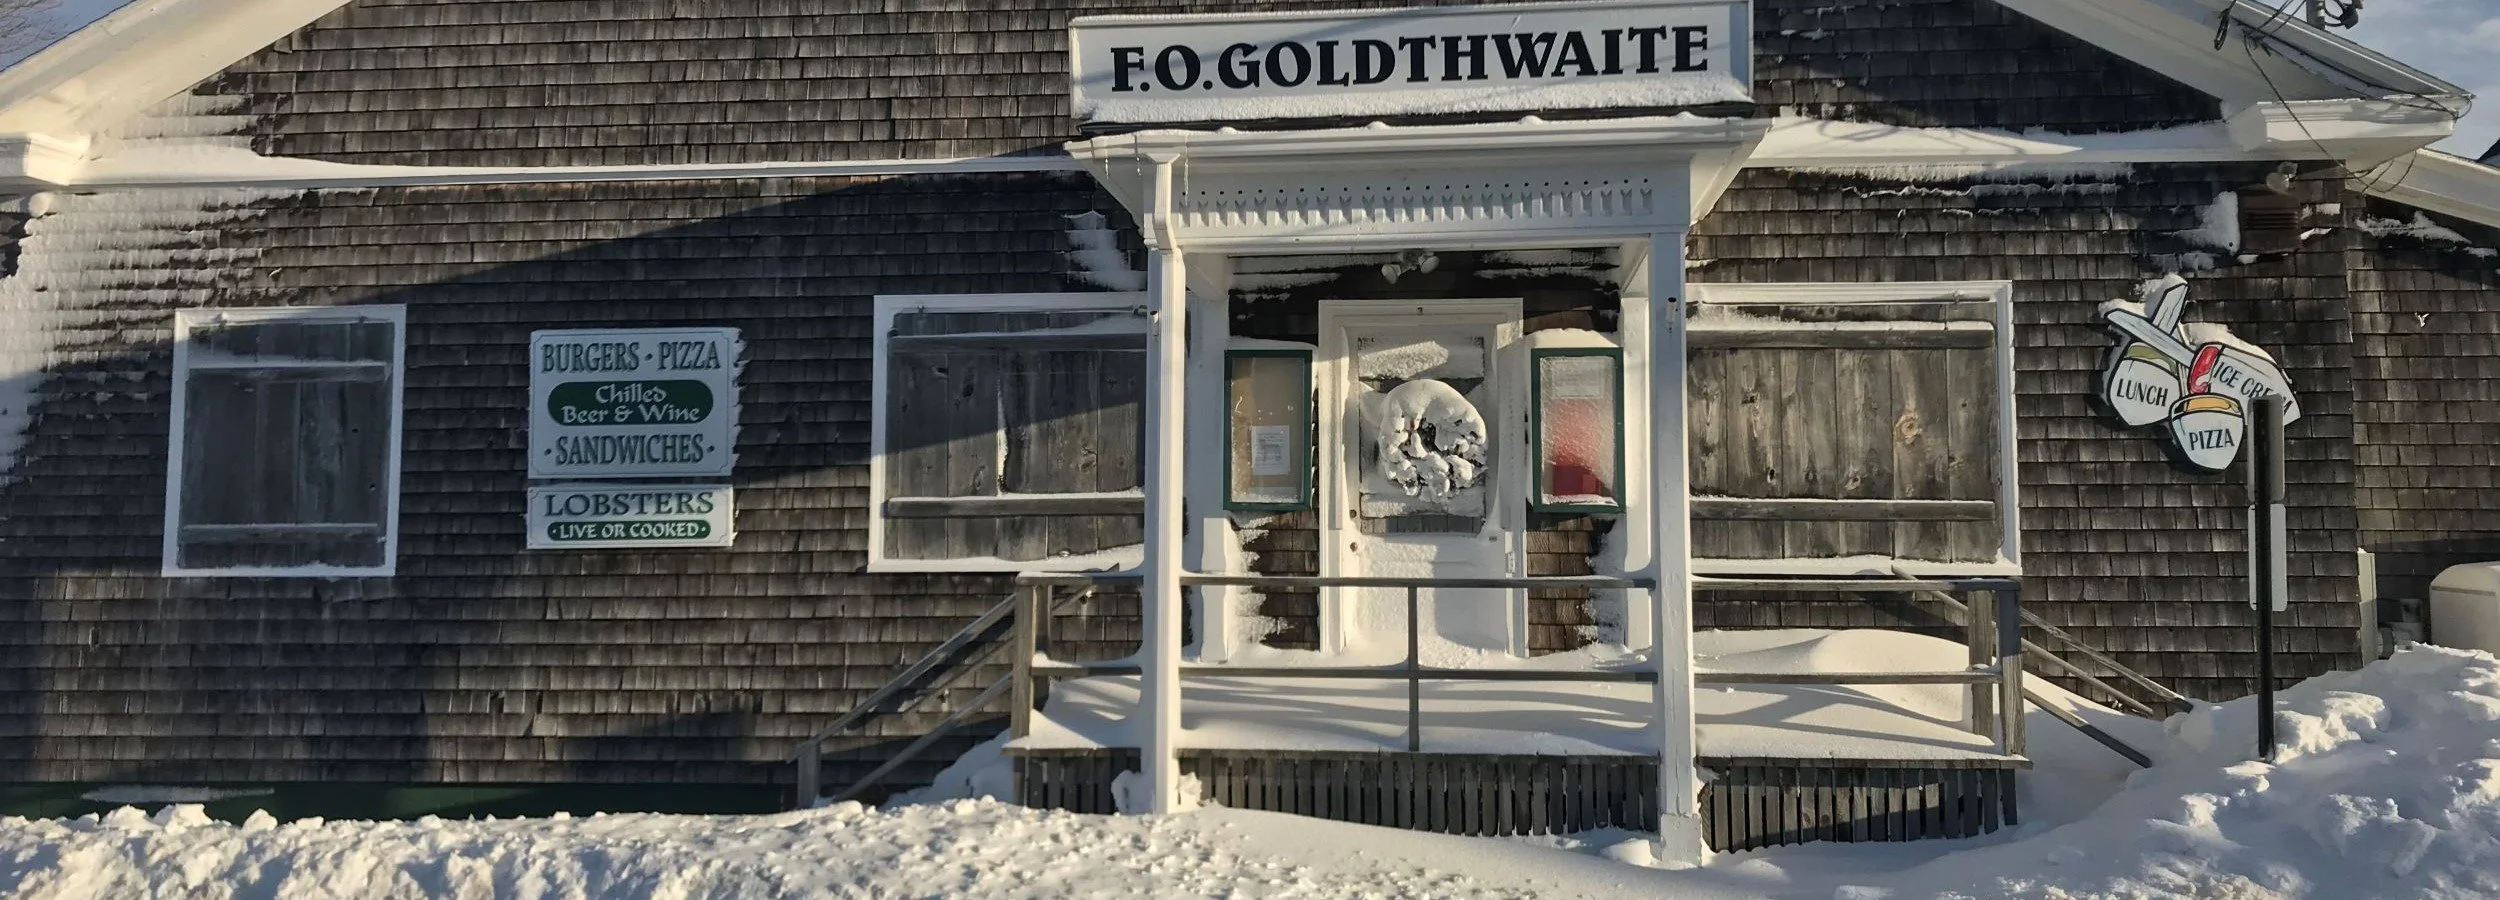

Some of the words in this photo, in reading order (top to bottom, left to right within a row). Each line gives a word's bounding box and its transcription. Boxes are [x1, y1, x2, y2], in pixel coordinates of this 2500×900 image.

[541, 342, 640, 373] BURGERS
[657, 341, 721, 370] PIZZA
[2213, 362, 2242, 389] ICE
[595, 383, 667, 404] Chilled
[2116, 378, 2168, 407] LUNCH
[562, 406, 608, 424] Beer
[614, 405, 633, 423] &
[639, 404, 700, 422] Wine
[555, 433, 704, 466] SANDWICHES
[2189, 428, 2235, 451] PIZZA
[544, 491, 714, 517] LOBSTERS
[560, 523, 597, 539] LIVE
[602, 522, 625, 538] OR
[630, 521, 699, 537] COOKED
